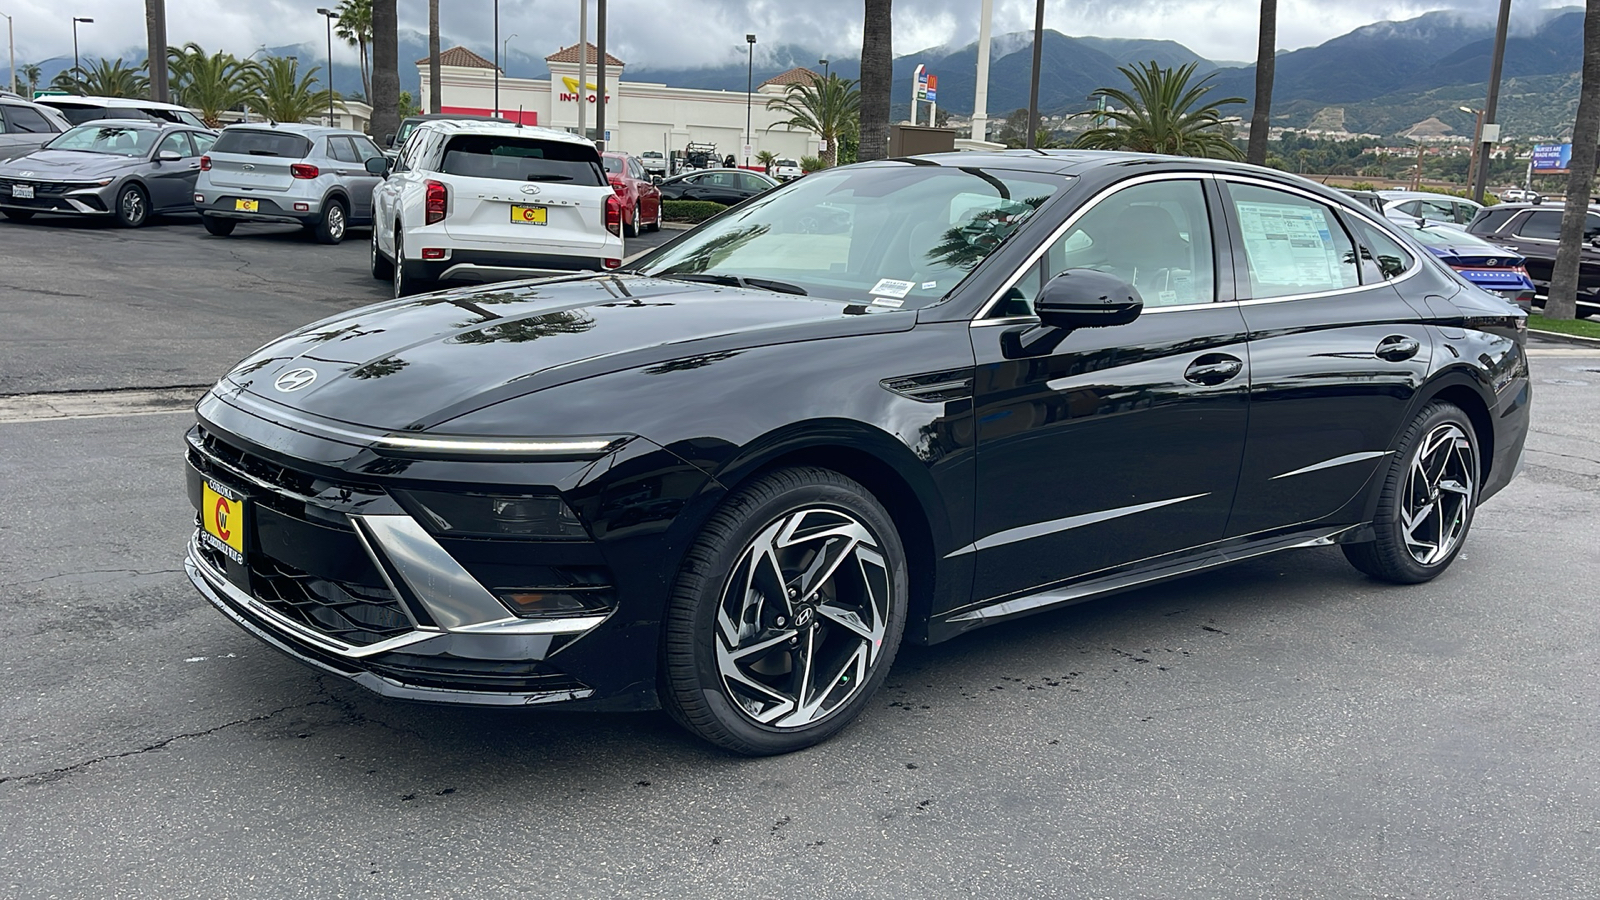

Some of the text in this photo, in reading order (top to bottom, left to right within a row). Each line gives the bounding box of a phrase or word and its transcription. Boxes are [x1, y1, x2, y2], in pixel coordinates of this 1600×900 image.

[560, 93, 610, 104] IN-N-OT
[478, 195, 580, 206] PALISADE
[209, 480, 234, 500] CORONA
